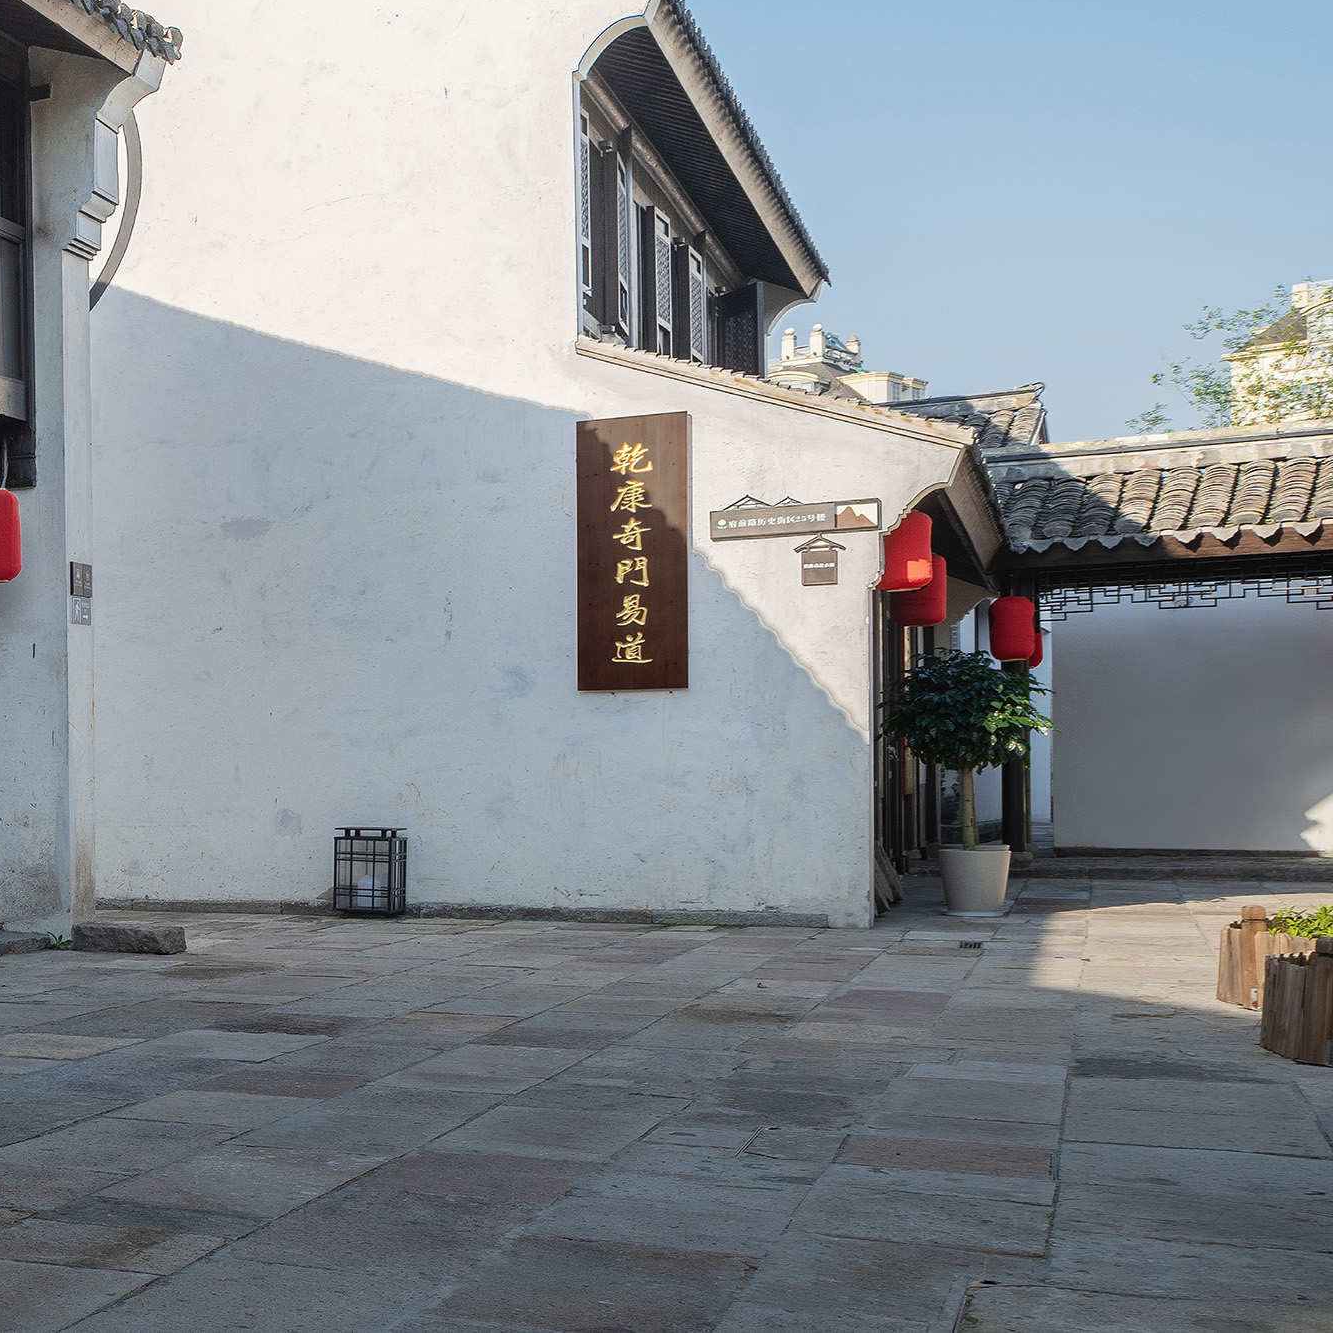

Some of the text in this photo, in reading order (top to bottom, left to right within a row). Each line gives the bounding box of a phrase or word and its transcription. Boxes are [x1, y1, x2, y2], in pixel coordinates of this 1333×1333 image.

[609, 442, 654, 664] 乾康奇門易道
